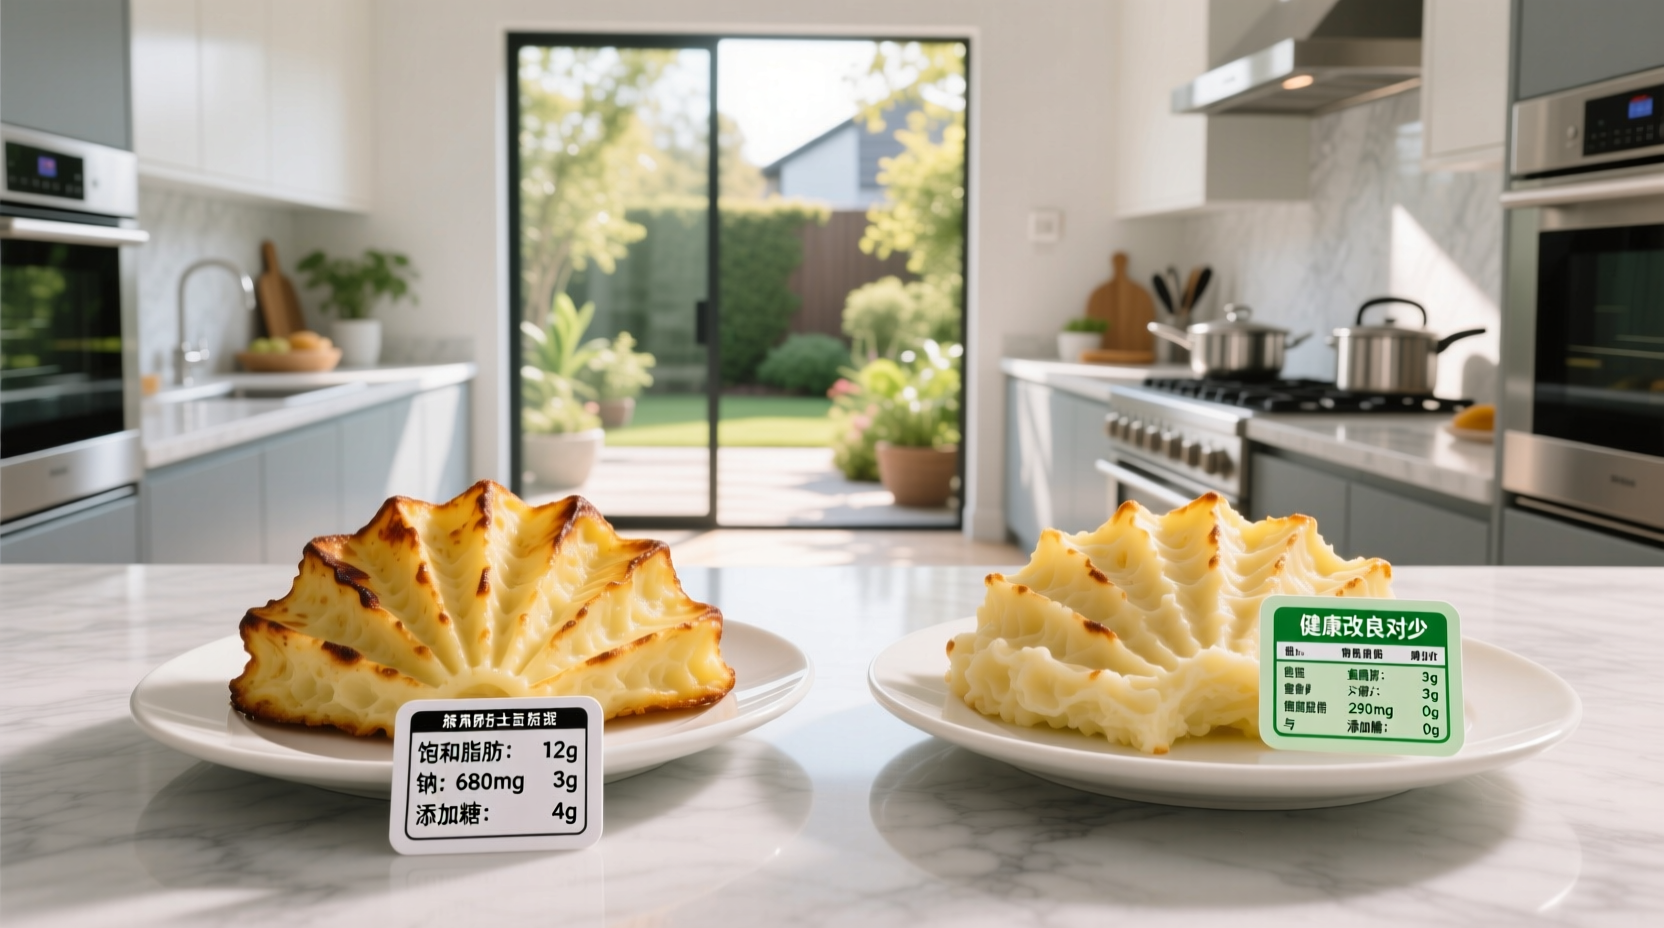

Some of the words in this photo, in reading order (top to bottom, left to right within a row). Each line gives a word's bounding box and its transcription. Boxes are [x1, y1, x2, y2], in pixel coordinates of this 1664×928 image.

[1300, 613, 1428, 640] 健康改良对少
[1421, 671, 1438, 686] 3g
[1421, 688, 1439, 703] 3g
[1348, 702, 1394, 719] 290mg
[1422, 705, 1440, 720] 0g
[1422, 722, 1440, 738] 0g
[542, 740, 578, 763] 12g
[455, 772, 525, 795] 680mg
[552, 770, 578, 793] 3g
[551, 801, 578, 825] 4g
